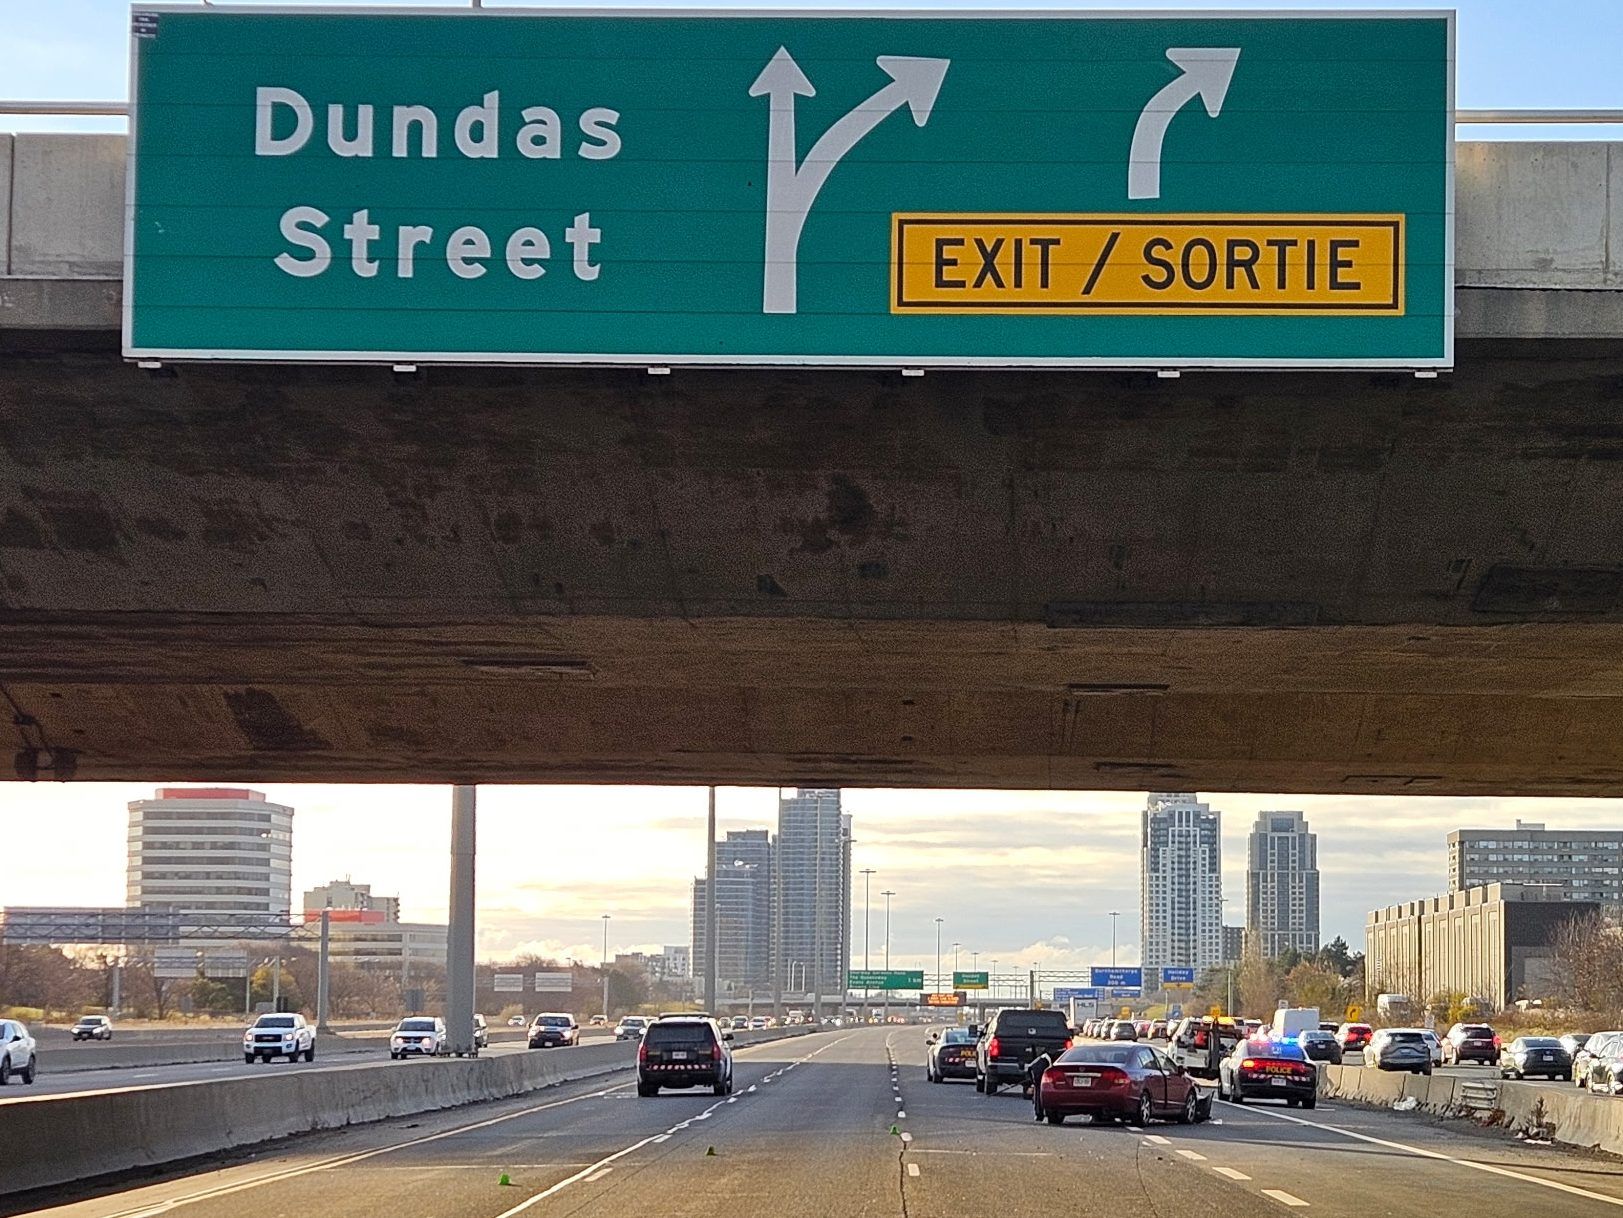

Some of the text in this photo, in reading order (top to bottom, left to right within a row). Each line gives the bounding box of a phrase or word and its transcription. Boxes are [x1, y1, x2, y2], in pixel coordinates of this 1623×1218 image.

[255, 85, 622, 160] Dundas
[273, 206, 602, 281] Street
[933, 231, 1362, 296] EXIT / SORTIE
[1265, 1066, 1292, 1074] POLICE
